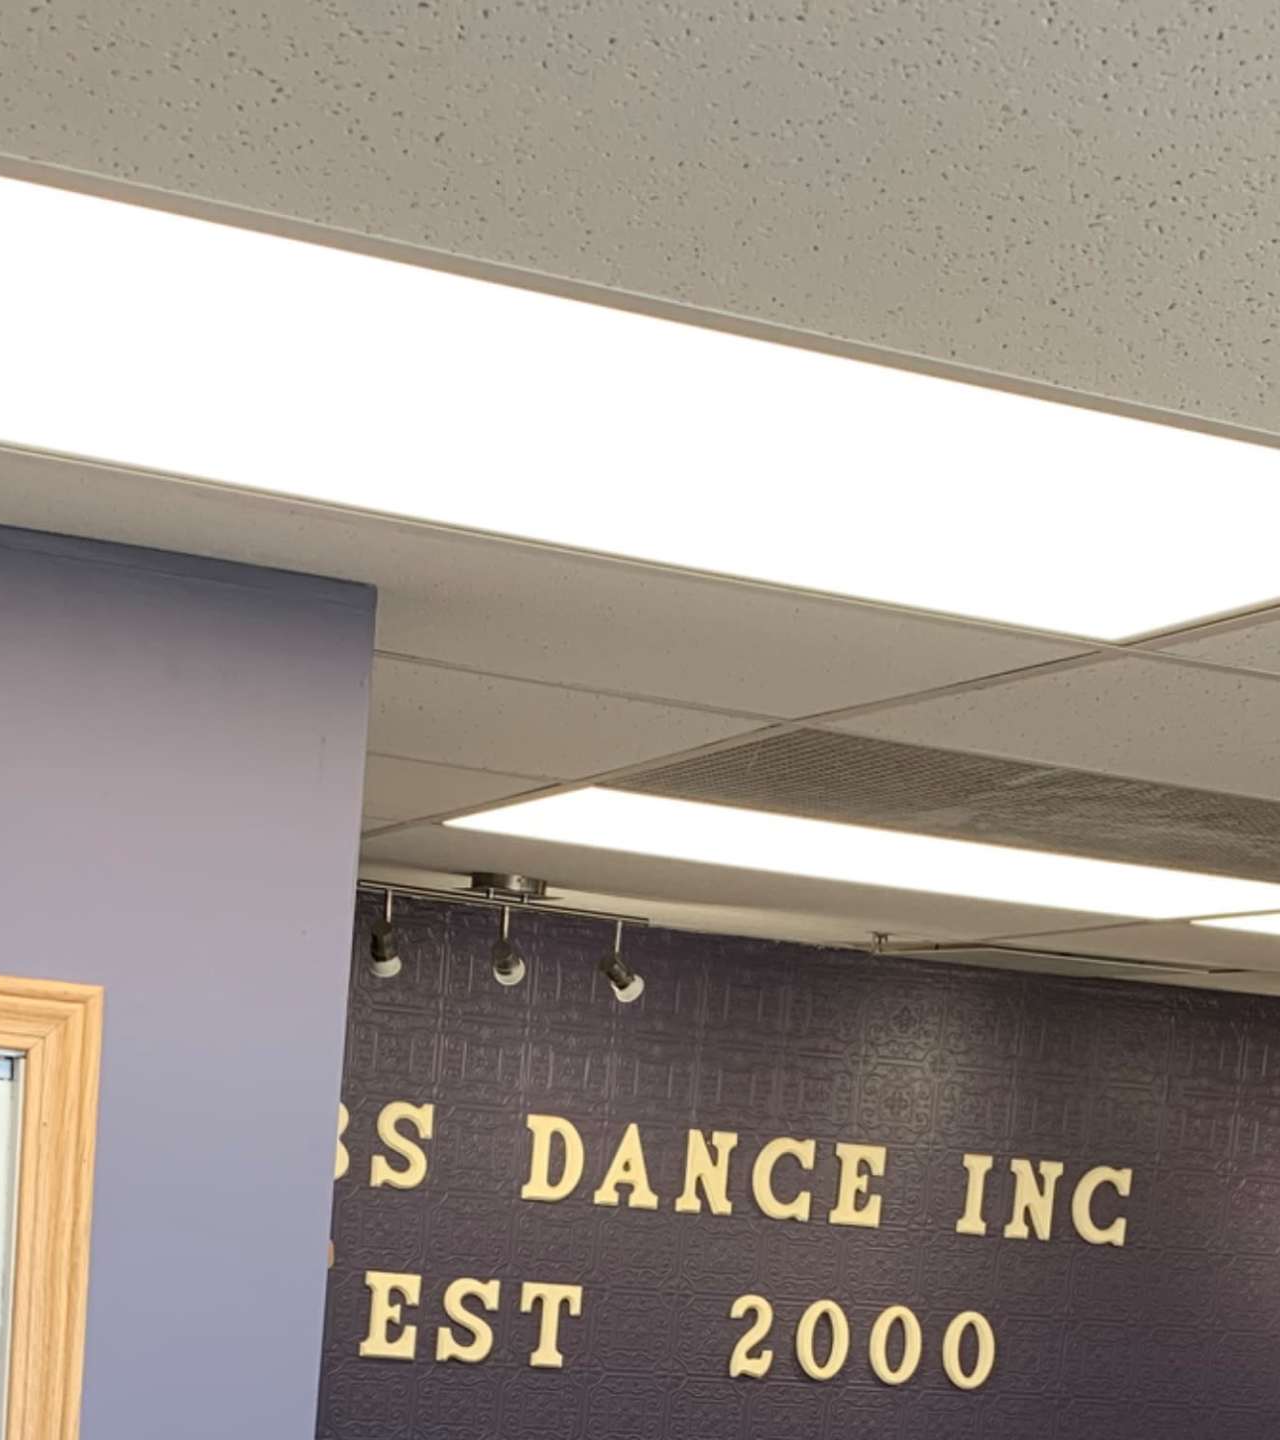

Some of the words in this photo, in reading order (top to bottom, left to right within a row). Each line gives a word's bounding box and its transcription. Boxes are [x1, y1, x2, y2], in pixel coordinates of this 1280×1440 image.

[521, 1114, 887, 1228] DANCE
[955, 1153, 1134, 1247] INC
[358, 1270, 583, 1369] EST
[728, 1294, 997, 1391] 2000
